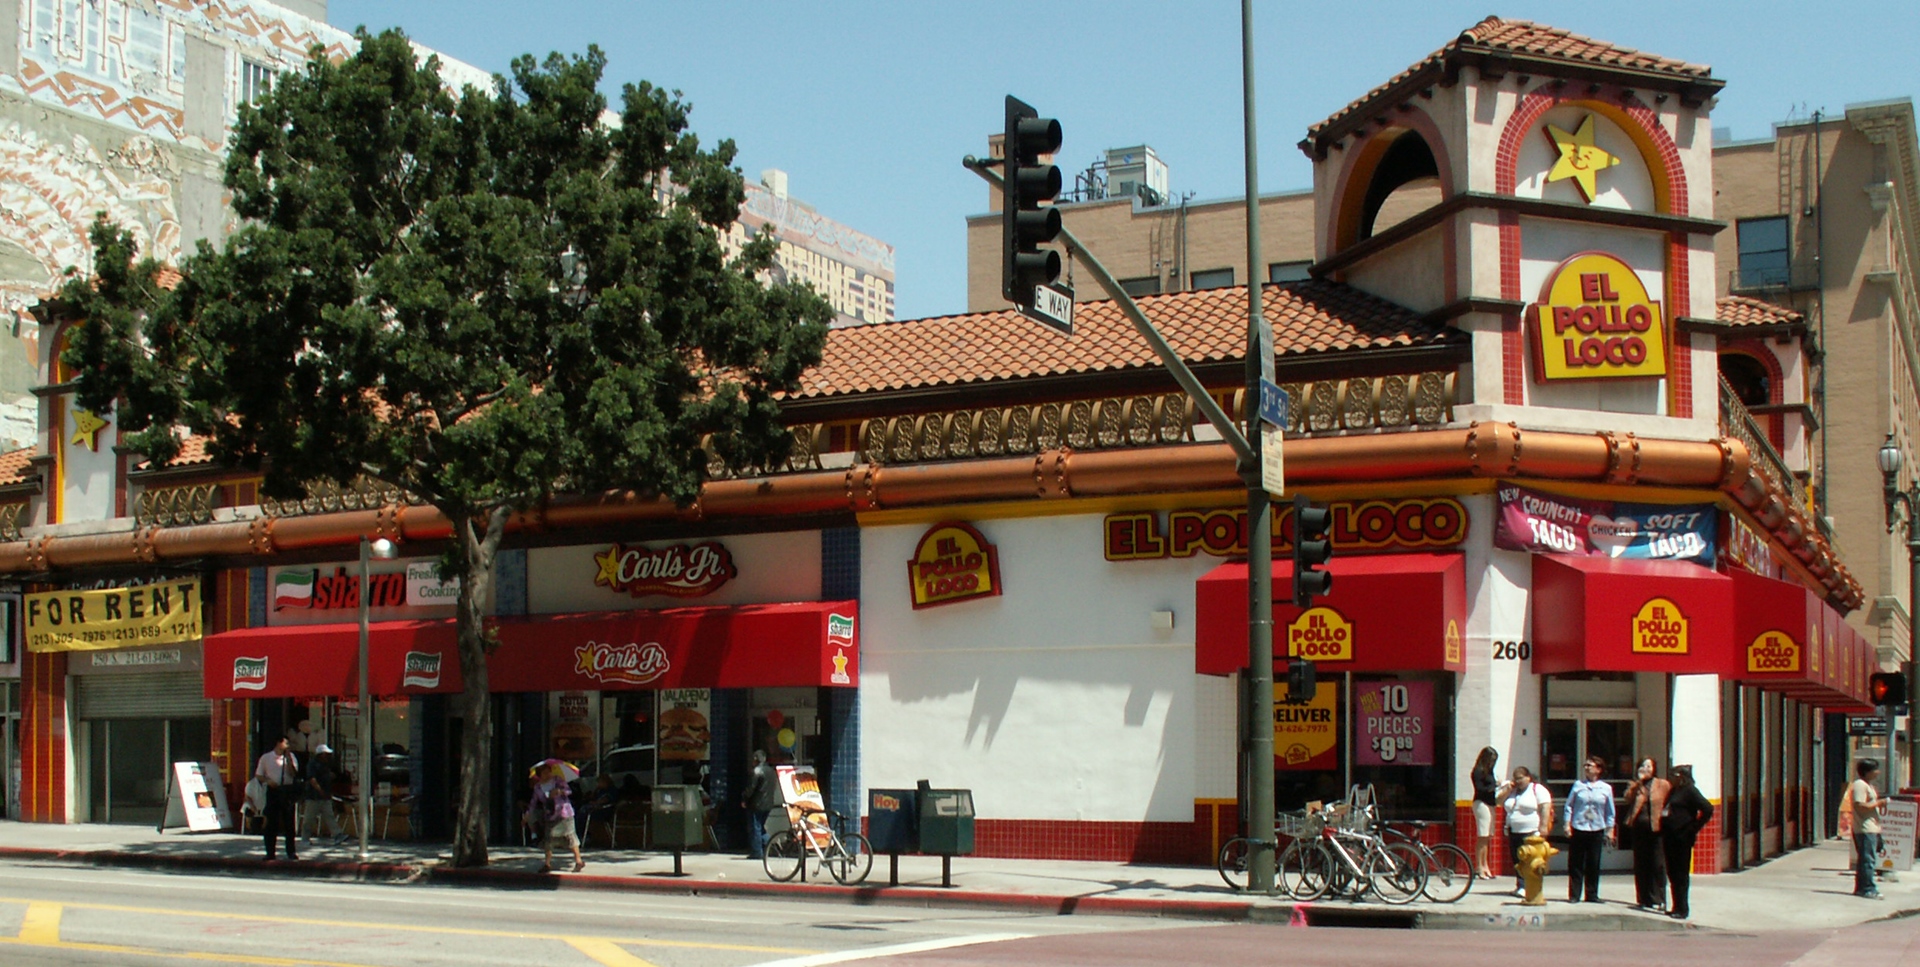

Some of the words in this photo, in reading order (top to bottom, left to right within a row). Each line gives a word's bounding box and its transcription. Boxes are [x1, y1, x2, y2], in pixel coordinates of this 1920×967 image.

[1580, 272, 1619, 302] EL
[1048, 290, 1069, 321] WAY
[1552, 303, 1652, 336] POLLO
[1563, 335, 1647, 368] LOCO
[1499, 486, 1520, 503] NEW
[1107, 517, 1163, 556] EL
[1333, 501, 1461, 544] LOCO
[1591, 523, 1634, 537] CHICKEN
[1643, 512, 1701, 531] SOFT
[1527, 518, 1577, 551] TACO
[1648, 531, 1698, 557] TACO
[936, 536, 961, 556] EL
[617, 548, 685, 583] Carl's
[686, 546, 726, 581] Jr.
[919, 551, 983, 580] POLLO
[313, 566, 405, 610] sbaro
[925, 573, 980, 598] LOCO
[29, 596, 86, 627] FOR
[105, 583, 194, 621] RENT
[1652, 606, 1669, 621] EL
[830, 620, 852, 636] sbarro
[1309, 615, 1328, 628] EL
[1638, 620, 1682, 635] POLLO
[1292, 628, 1347, 642] POLLO
[1642, 634, 1680, 649] LOCO
[1765, 636, 1781, 648] EL
[593, 648, 638, 671] Carl's
[639, 645, 667, 672] Jr.
[1296, 642, 1342, 656] LOCO
[1492, 640, 1531, 661] 260
[1752, 646, 1795, 658] POLLO
[236, 659, 266, 678] sbarro
[406, 657, 439, 673] sbarro
[1756, 657, 1792, 669] LOCO
[1380, 684, 1409, 713] 10
[1273, 708, 1331, 723] ELIVER
[1367, 716, 1422, 735] PIECES
[1887, 809, 1914, 819] PIECES
[1505, 915, 1541, 927] 260
